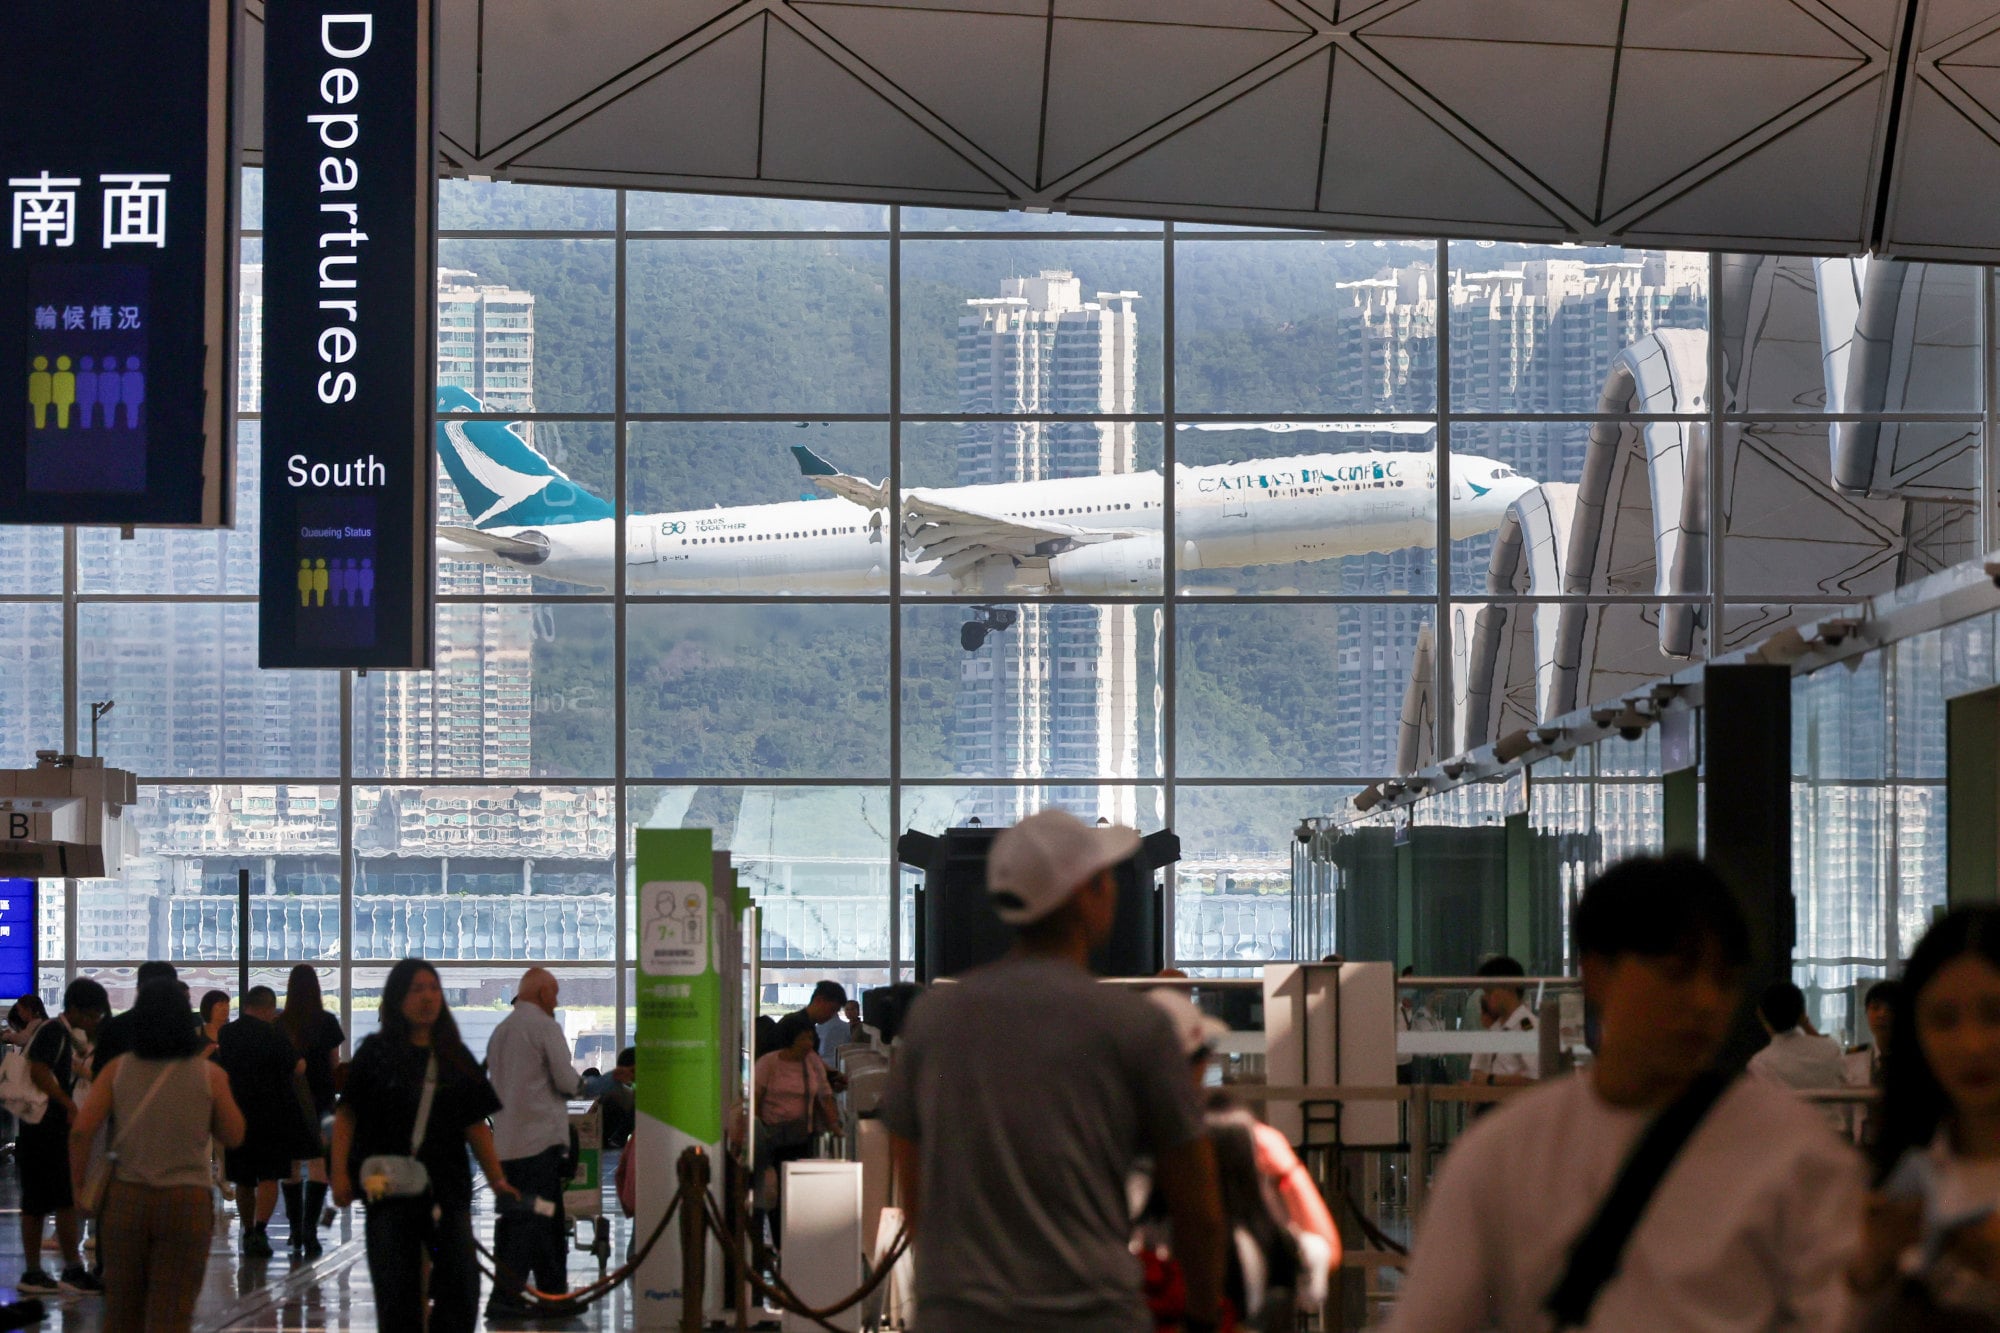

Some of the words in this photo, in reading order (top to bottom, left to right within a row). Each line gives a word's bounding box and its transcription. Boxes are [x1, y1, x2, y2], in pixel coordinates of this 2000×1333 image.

[8, 170, 171, 249] 南面
[306, 13, 373, 404] Departures
[35, 305, 141, 330] 輪候情況
[287, 454, 386, 487] South
[301, 526, 342, 540] Queueing
[344, 526, 372, 538] Status
[662, 521, 686, 535] 80
[10, 813, 29, 839] B
